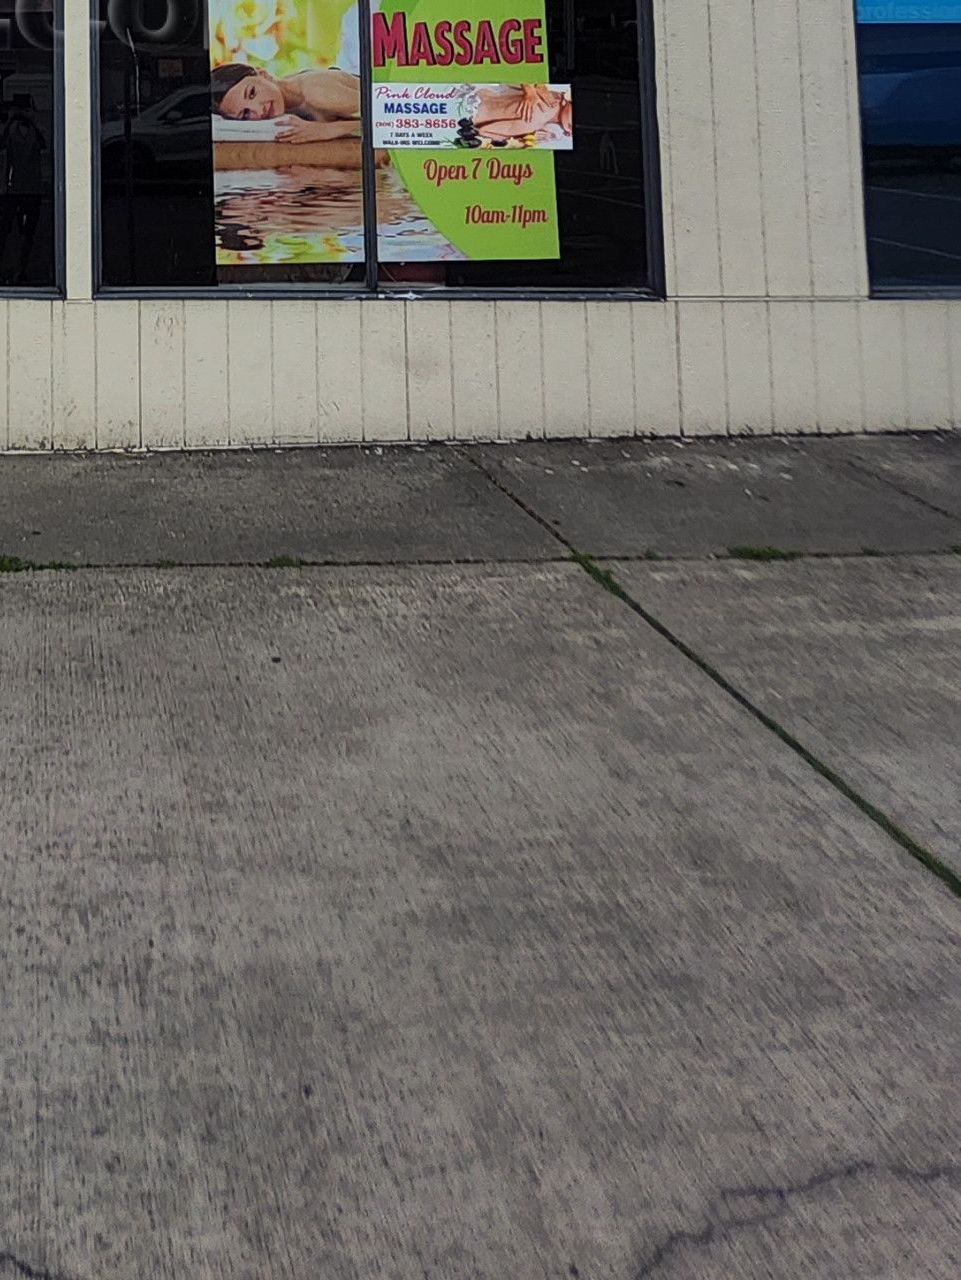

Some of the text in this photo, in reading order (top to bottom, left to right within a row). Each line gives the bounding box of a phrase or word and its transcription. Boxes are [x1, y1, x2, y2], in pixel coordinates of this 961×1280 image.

[371, 11, 545, 68] MASSAGE
[374, 86, 457, 99] Pink Cloud
[384, 103, 448, 114] MASSAGE
[395, 118, 457, 129] 383-8656
[423, 156, 534, 187] Open 7 Days
[464, 204, 549, 229] 10am-11pm
